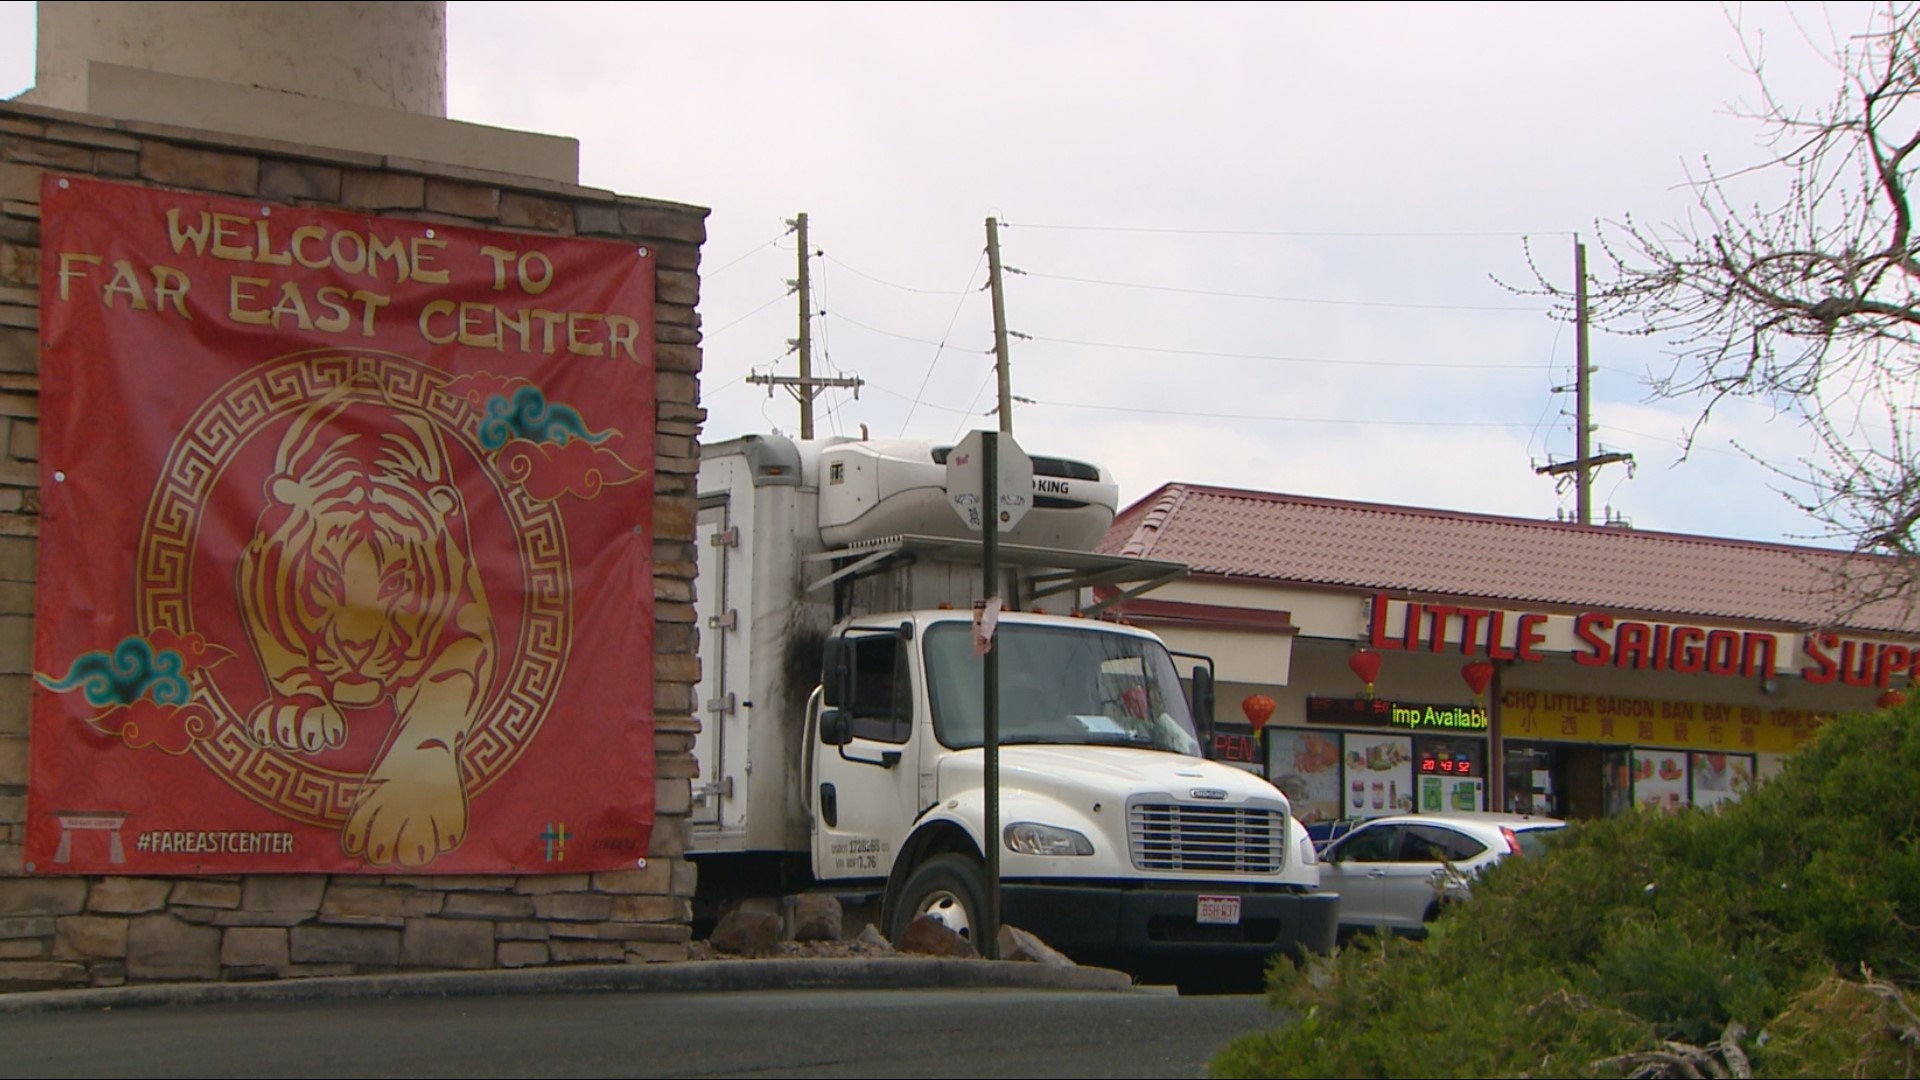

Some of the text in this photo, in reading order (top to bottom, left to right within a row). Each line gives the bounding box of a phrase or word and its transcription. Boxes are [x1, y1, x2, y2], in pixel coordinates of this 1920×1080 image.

[166, 208, 553, 294] WELCOME TO
[58, 253, 642, 365] FAR EAST CENTER
[1038, 479, 1069, 494] KING
[1369, 592, 1549, 662] LITTLE
[1573, 612, 1777, 679] SAIGON
[1392, 703, 1421, 729] imp
[1543, 694, 1590, 714] LITTLE
[1597, 697, 1655, 718] SAIGON
[137, 830, 294, 853] #FAREASTCENTER
